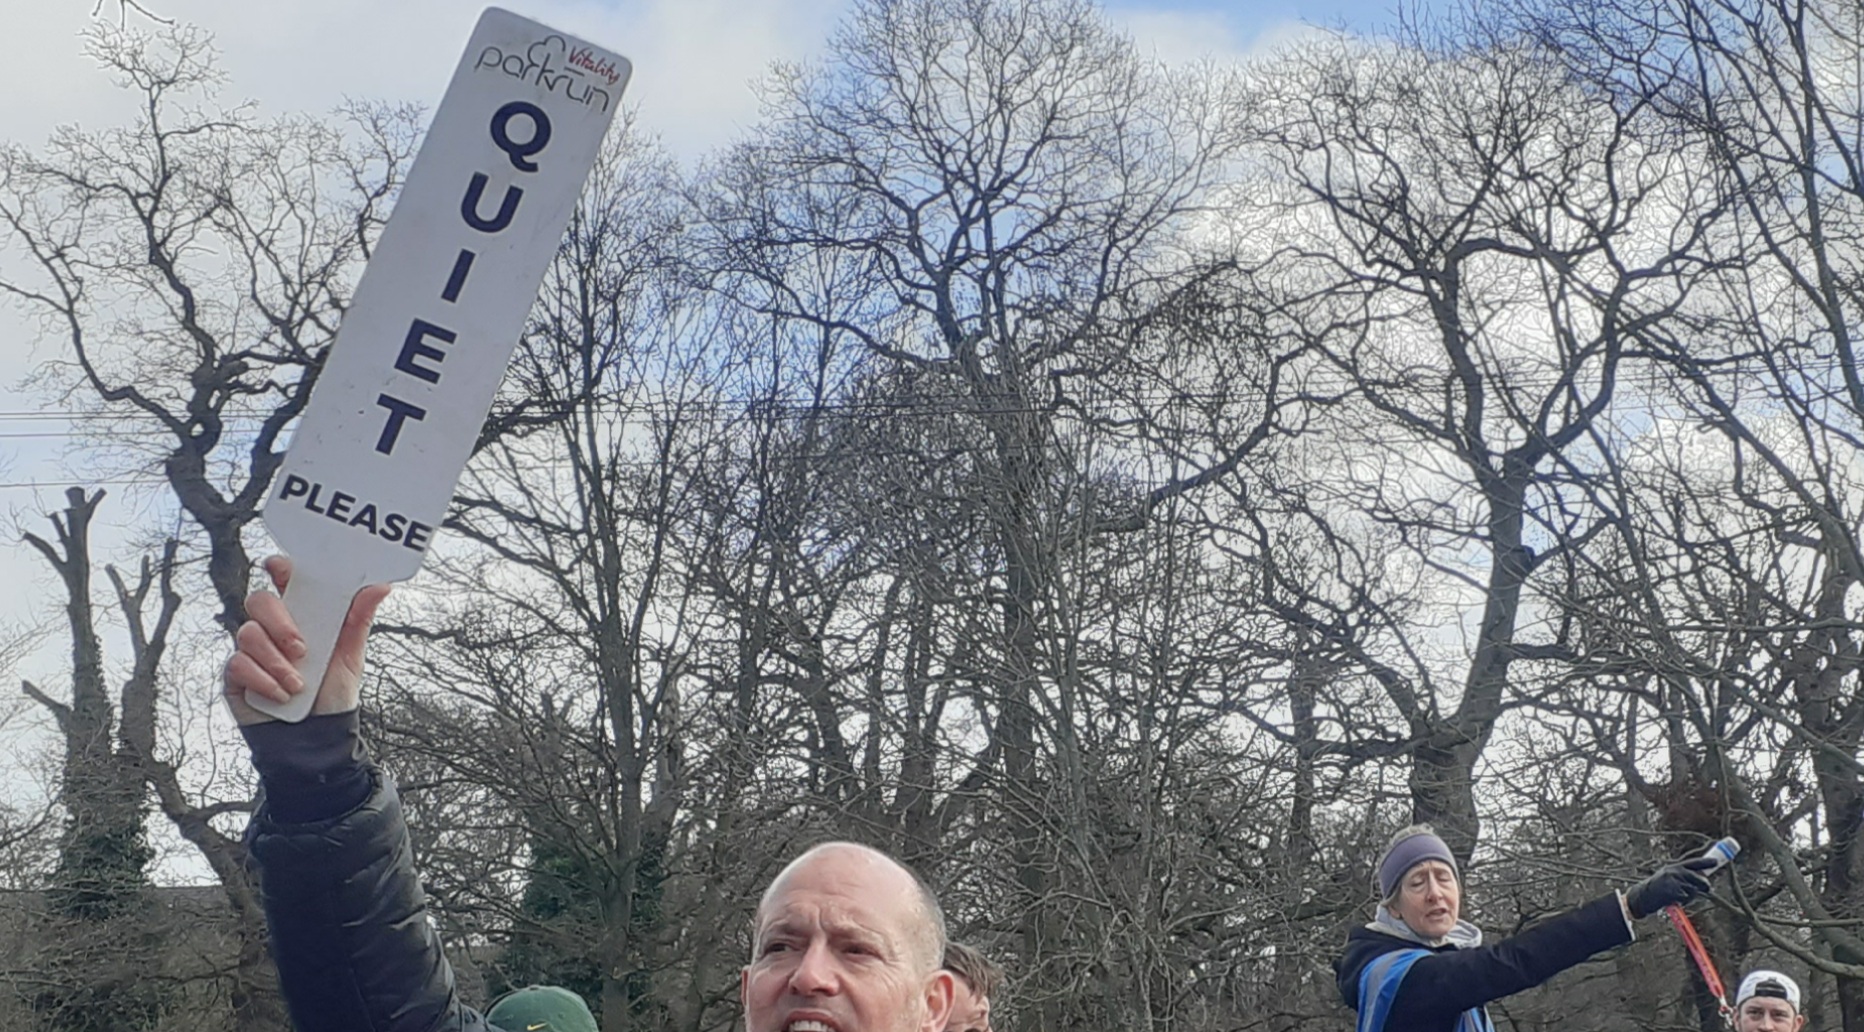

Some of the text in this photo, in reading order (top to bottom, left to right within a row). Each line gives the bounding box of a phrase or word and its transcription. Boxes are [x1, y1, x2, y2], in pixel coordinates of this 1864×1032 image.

[474, 44, 610, 112] parkrun
[568, 45, 621, 86] Vitality
[374, 101, 552, 456] QUIET
[279, 474, 433, 552] PLEASE
